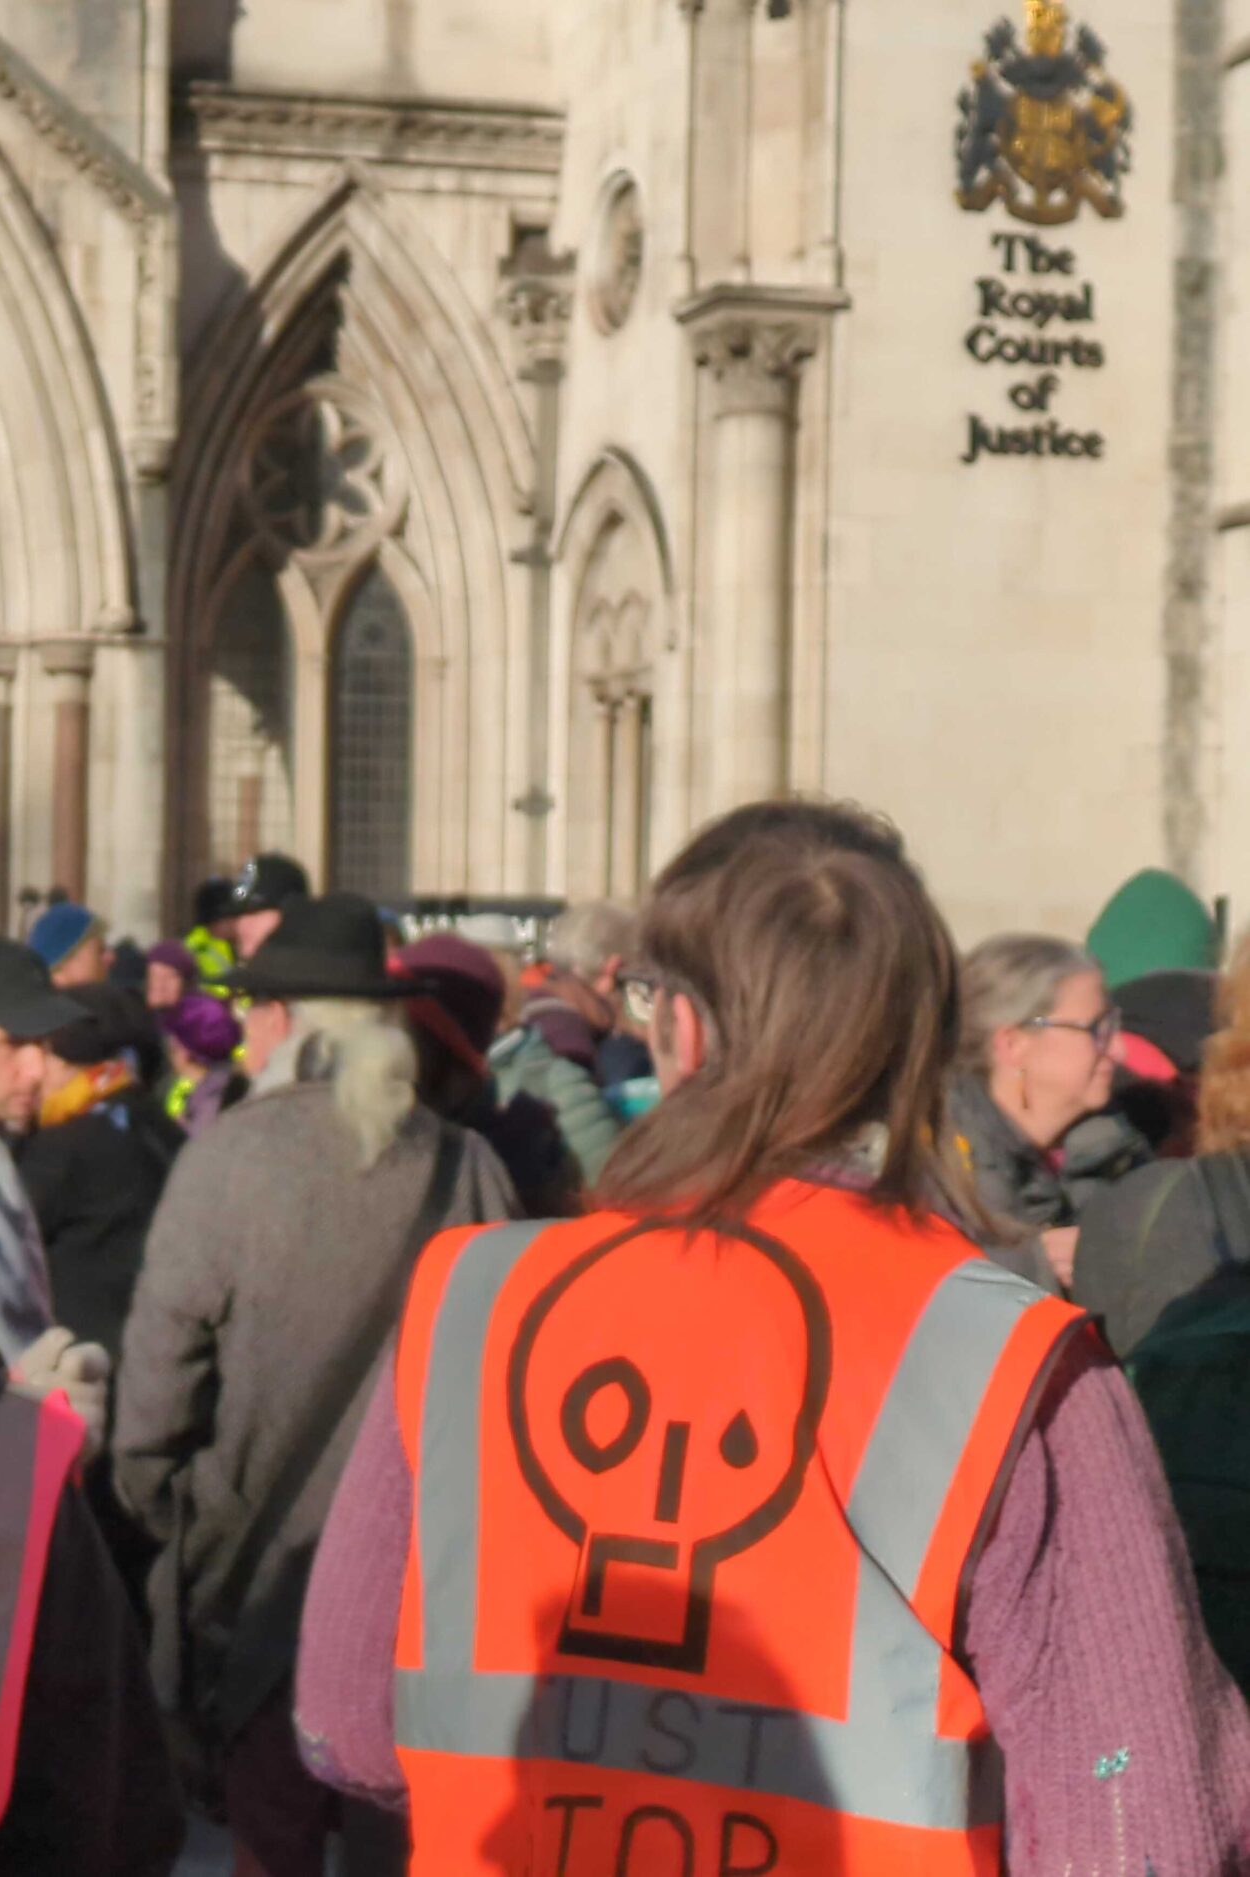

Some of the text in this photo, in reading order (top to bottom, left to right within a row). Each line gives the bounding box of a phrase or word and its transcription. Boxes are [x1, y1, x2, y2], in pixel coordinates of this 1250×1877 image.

[991, 232, 1075, 275] The
[976, 277, 1094, 329] Royal
[964, 324, 1105, 369] Courts
[1008, 374, 1059, 412] of
[961, 413, 1105, 464] Justice
